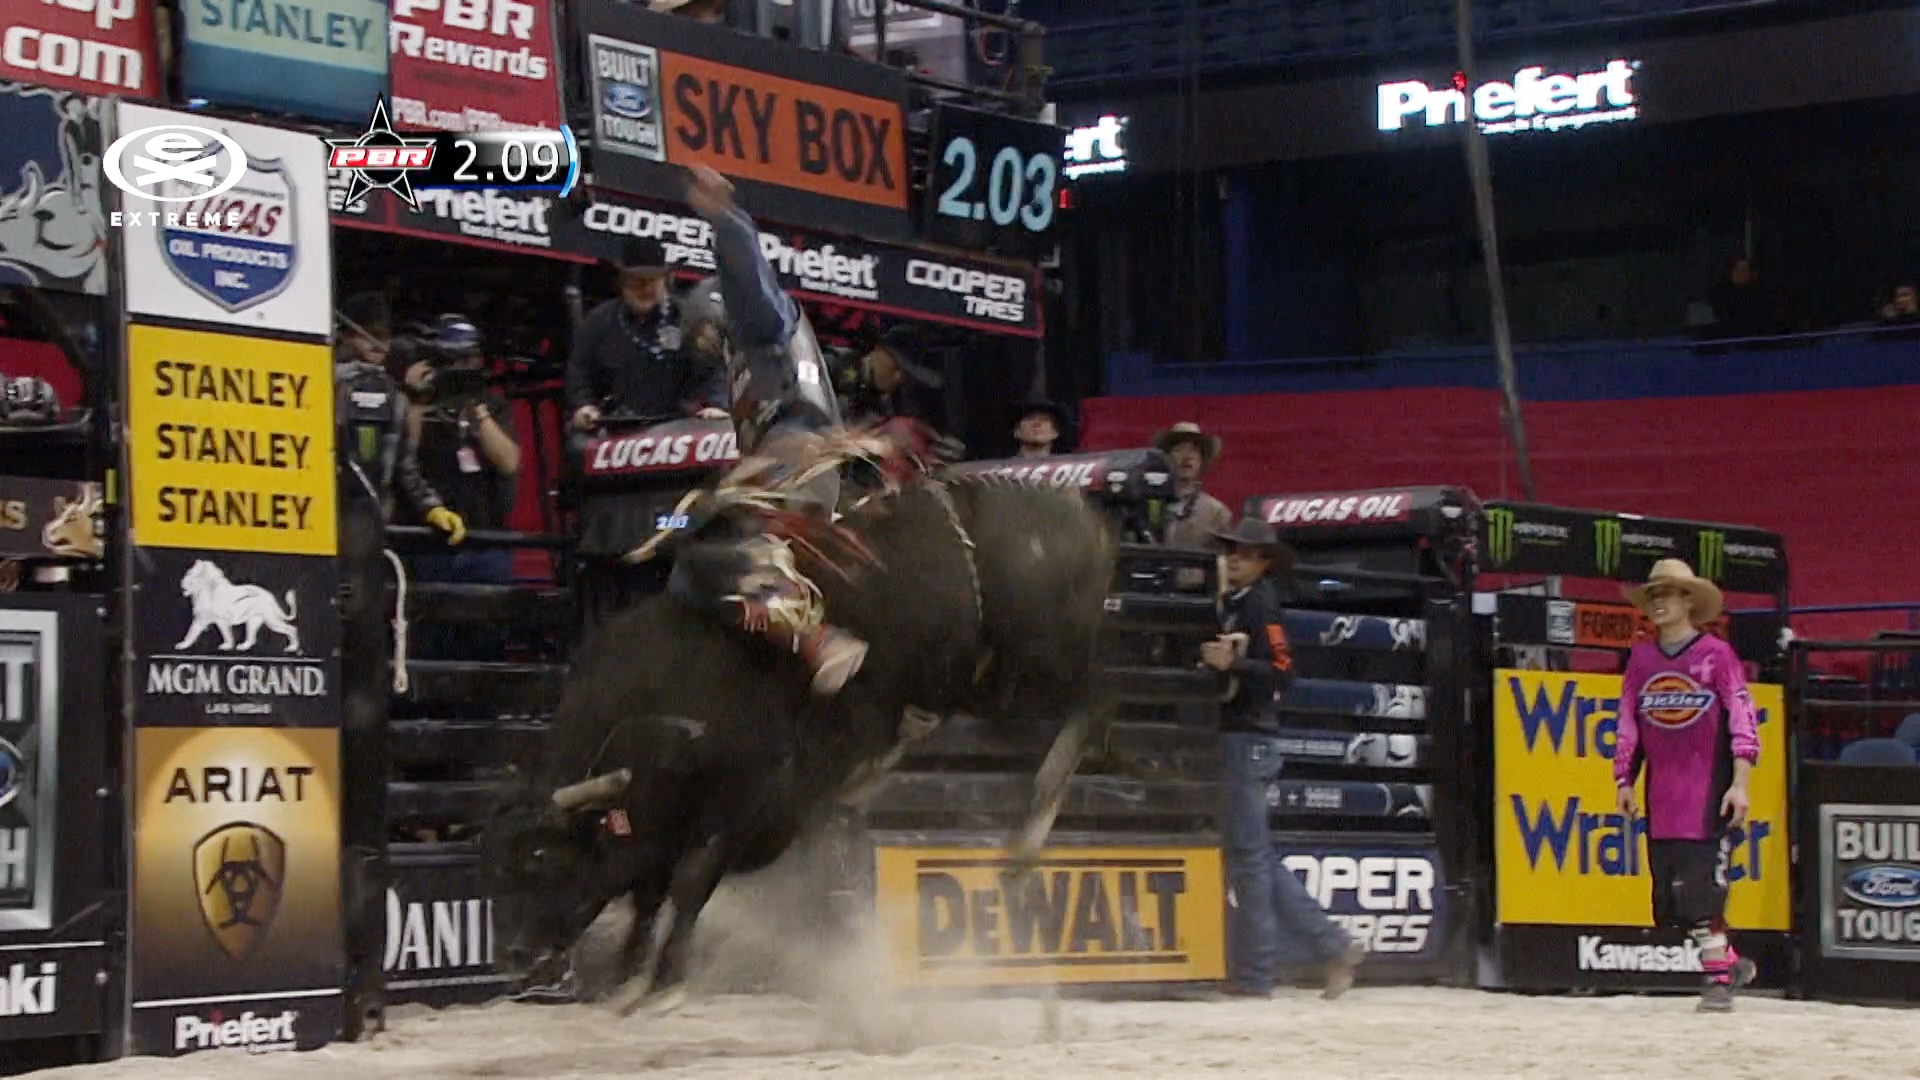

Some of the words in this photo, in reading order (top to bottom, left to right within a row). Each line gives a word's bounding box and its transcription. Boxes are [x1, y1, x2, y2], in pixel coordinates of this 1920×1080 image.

[202, 0, 373, 51] STANLEY
[3, 26, 143, 90] com
[389, 20, 548, 81] Rewards
[597, 49, 649, 87] BUILT
[1377, 59, 1634, 131] Priefert
[674, 73, 778, 164] SKY
[796, 98, 897, 191] BOX
[938, 137, 1056, 232] 2.03
[584, 202, 717, 248] COOPER
[168, 238, 201, 259] OIL
[202, 242, 288, 269] PRODUCTS
[758, 231, 877, 289] Priefert
[906, 258, 1026, 302] COOPER
[963, 295, 1025, 323] TIRES
[155, 360, 309, 409] STANLEY
[157, 423, 310, 470] STANLEY
[593, 434, 694, 470] LUCAS
[695, 431, 740, 462] OIL
[1052, 462, 1097, 487] OIL
[158, 486, 312, 530] STANLEY
[1267, 496, 1358, 524] LUCAS
[1359, 494, 1404, 519] OIL
[147, 663, 223, 695] MGM
[226, 664, 325, 696] GRAND
[164, 766, 315, 803] ARIAT
[1509, 794, 1770, 882] Wranr
[1327, 914, 1433, 953] RES
[1578, 935, 1706, 972] Kawasak
[175, 1009, 297, 1050] Priefert
